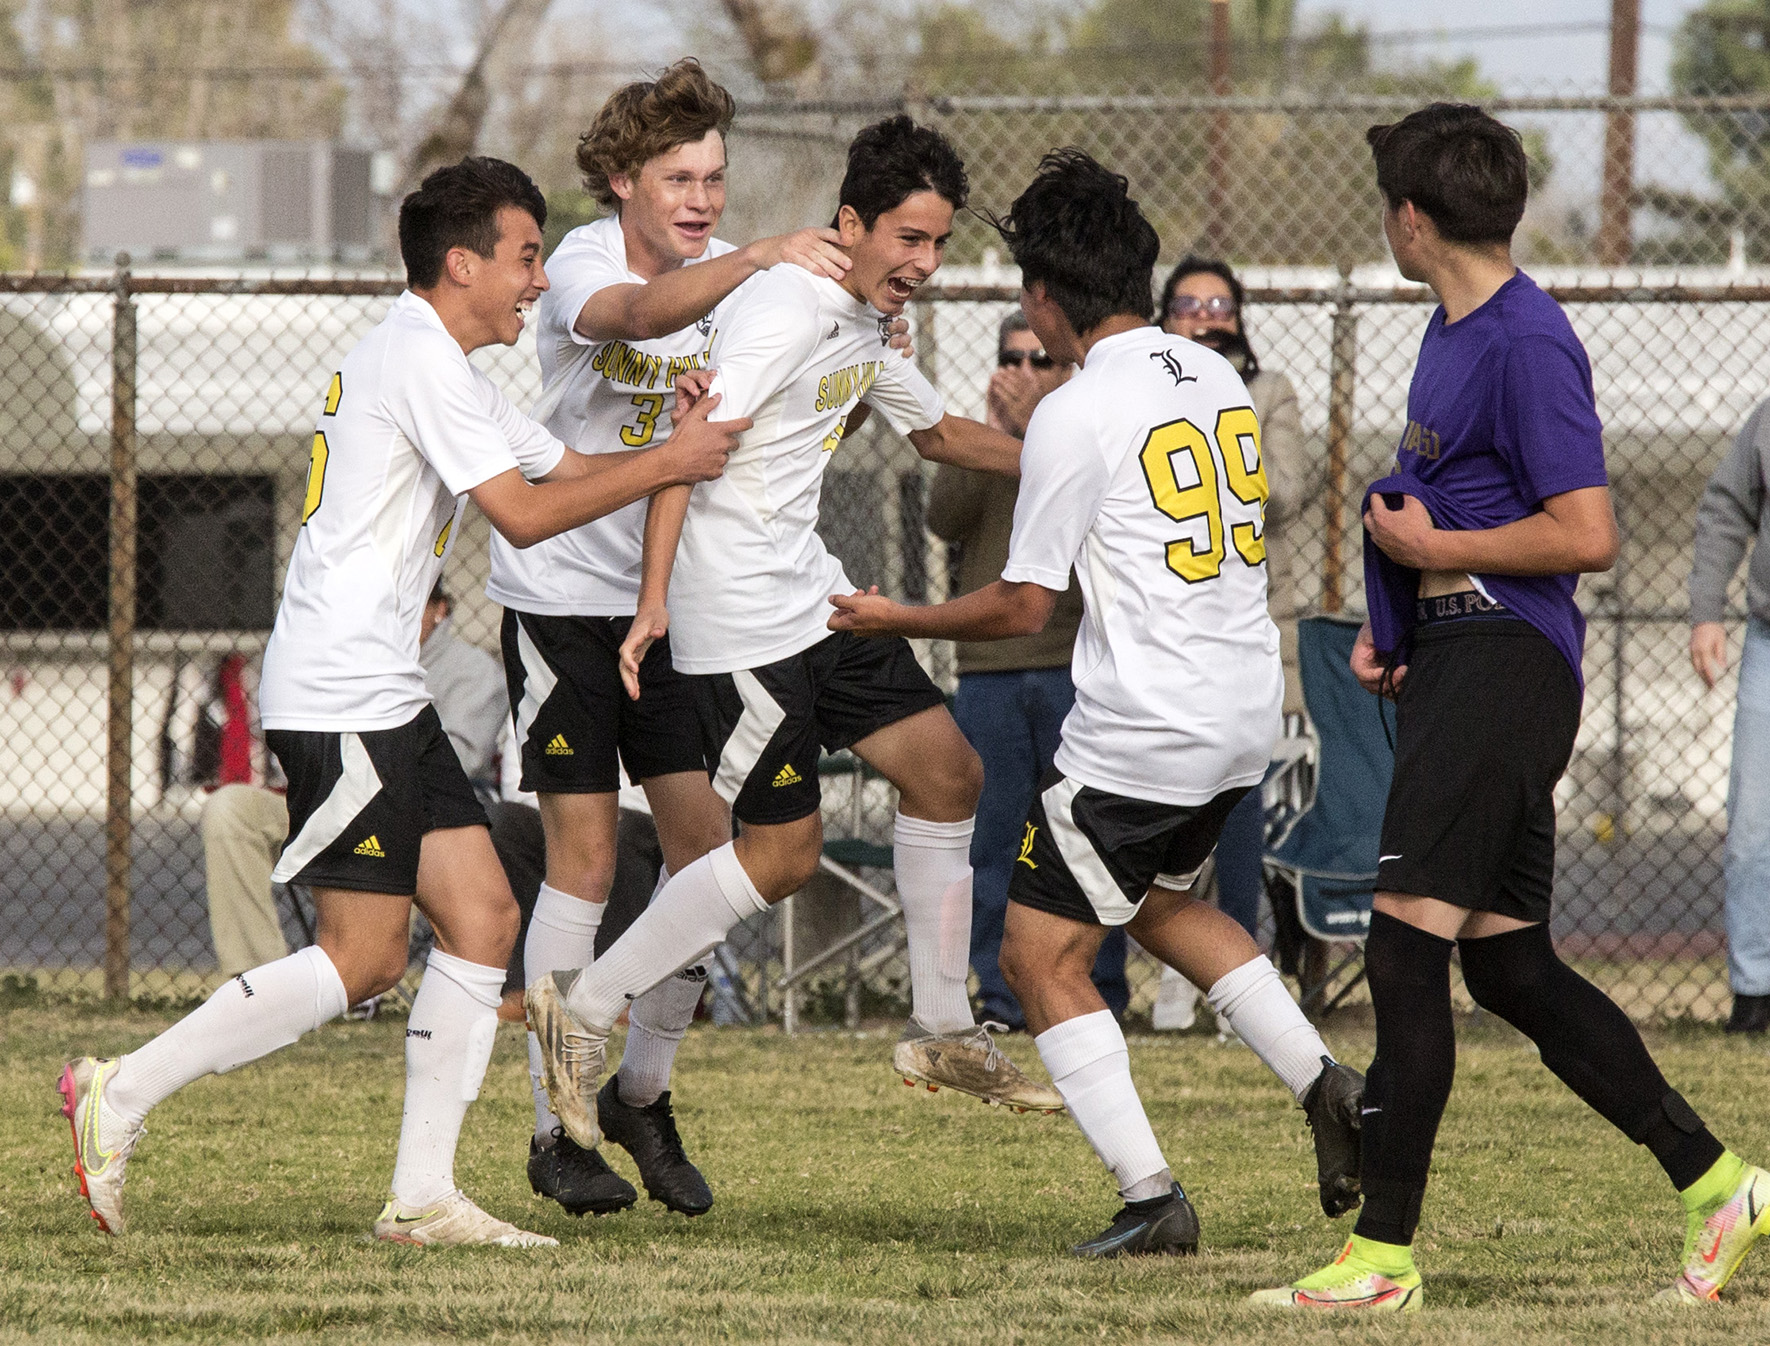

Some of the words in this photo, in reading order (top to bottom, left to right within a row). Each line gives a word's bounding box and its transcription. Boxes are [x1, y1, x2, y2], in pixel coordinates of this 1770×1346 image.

[592, 339, 663, 389] SUNNY
[815, 364, 860, 412] SUNNY
[619, 393, 665, 447] 3
[1138, 405, 1270, 585] 99
[545, 747, 574, 755] adidas
[772, 775, 802, 787] adidas
[353, 847, 386, 858] adidas
